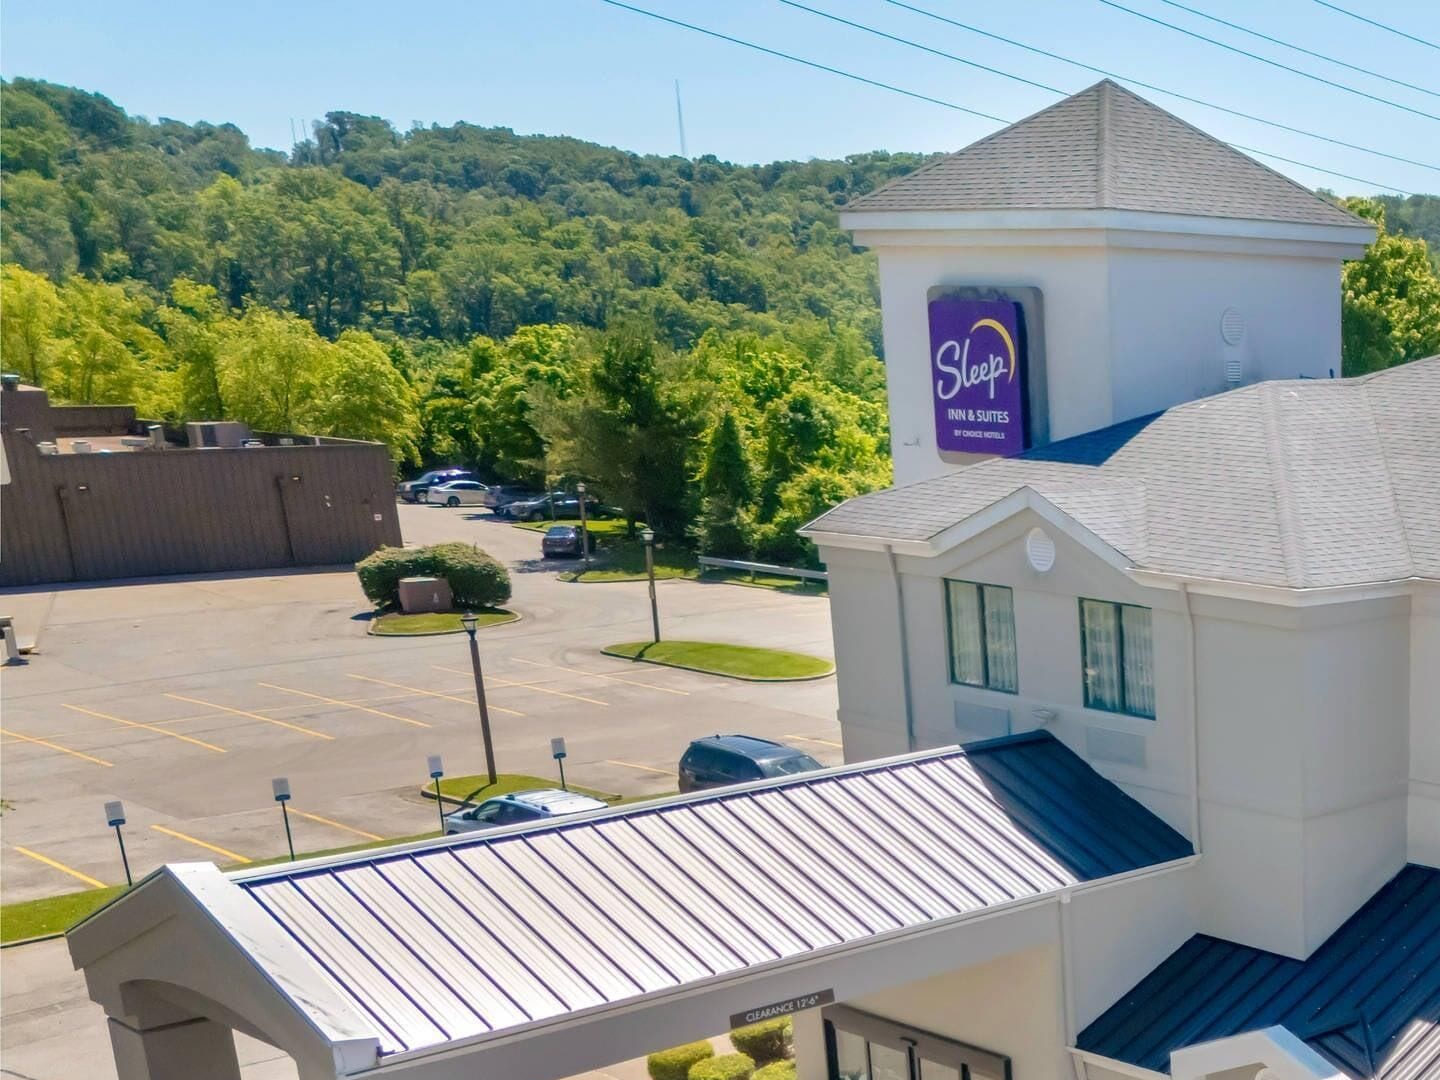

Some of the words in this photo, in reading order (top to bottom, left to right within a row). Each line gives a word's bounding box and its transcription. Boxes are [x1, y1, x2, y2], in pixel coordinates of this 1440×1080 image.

[937, 338, 1008, 399] Sleep
[948, 408, 966, 421] INN
[967, 409, 976, 421] &
[976, 410, 1009, 424] SUITES
[962, 430, 983, 438] CHOICE
[984, 431, 1005, 439] HOTELS
[745, 1001, 794, 1022] CLEARANCE
